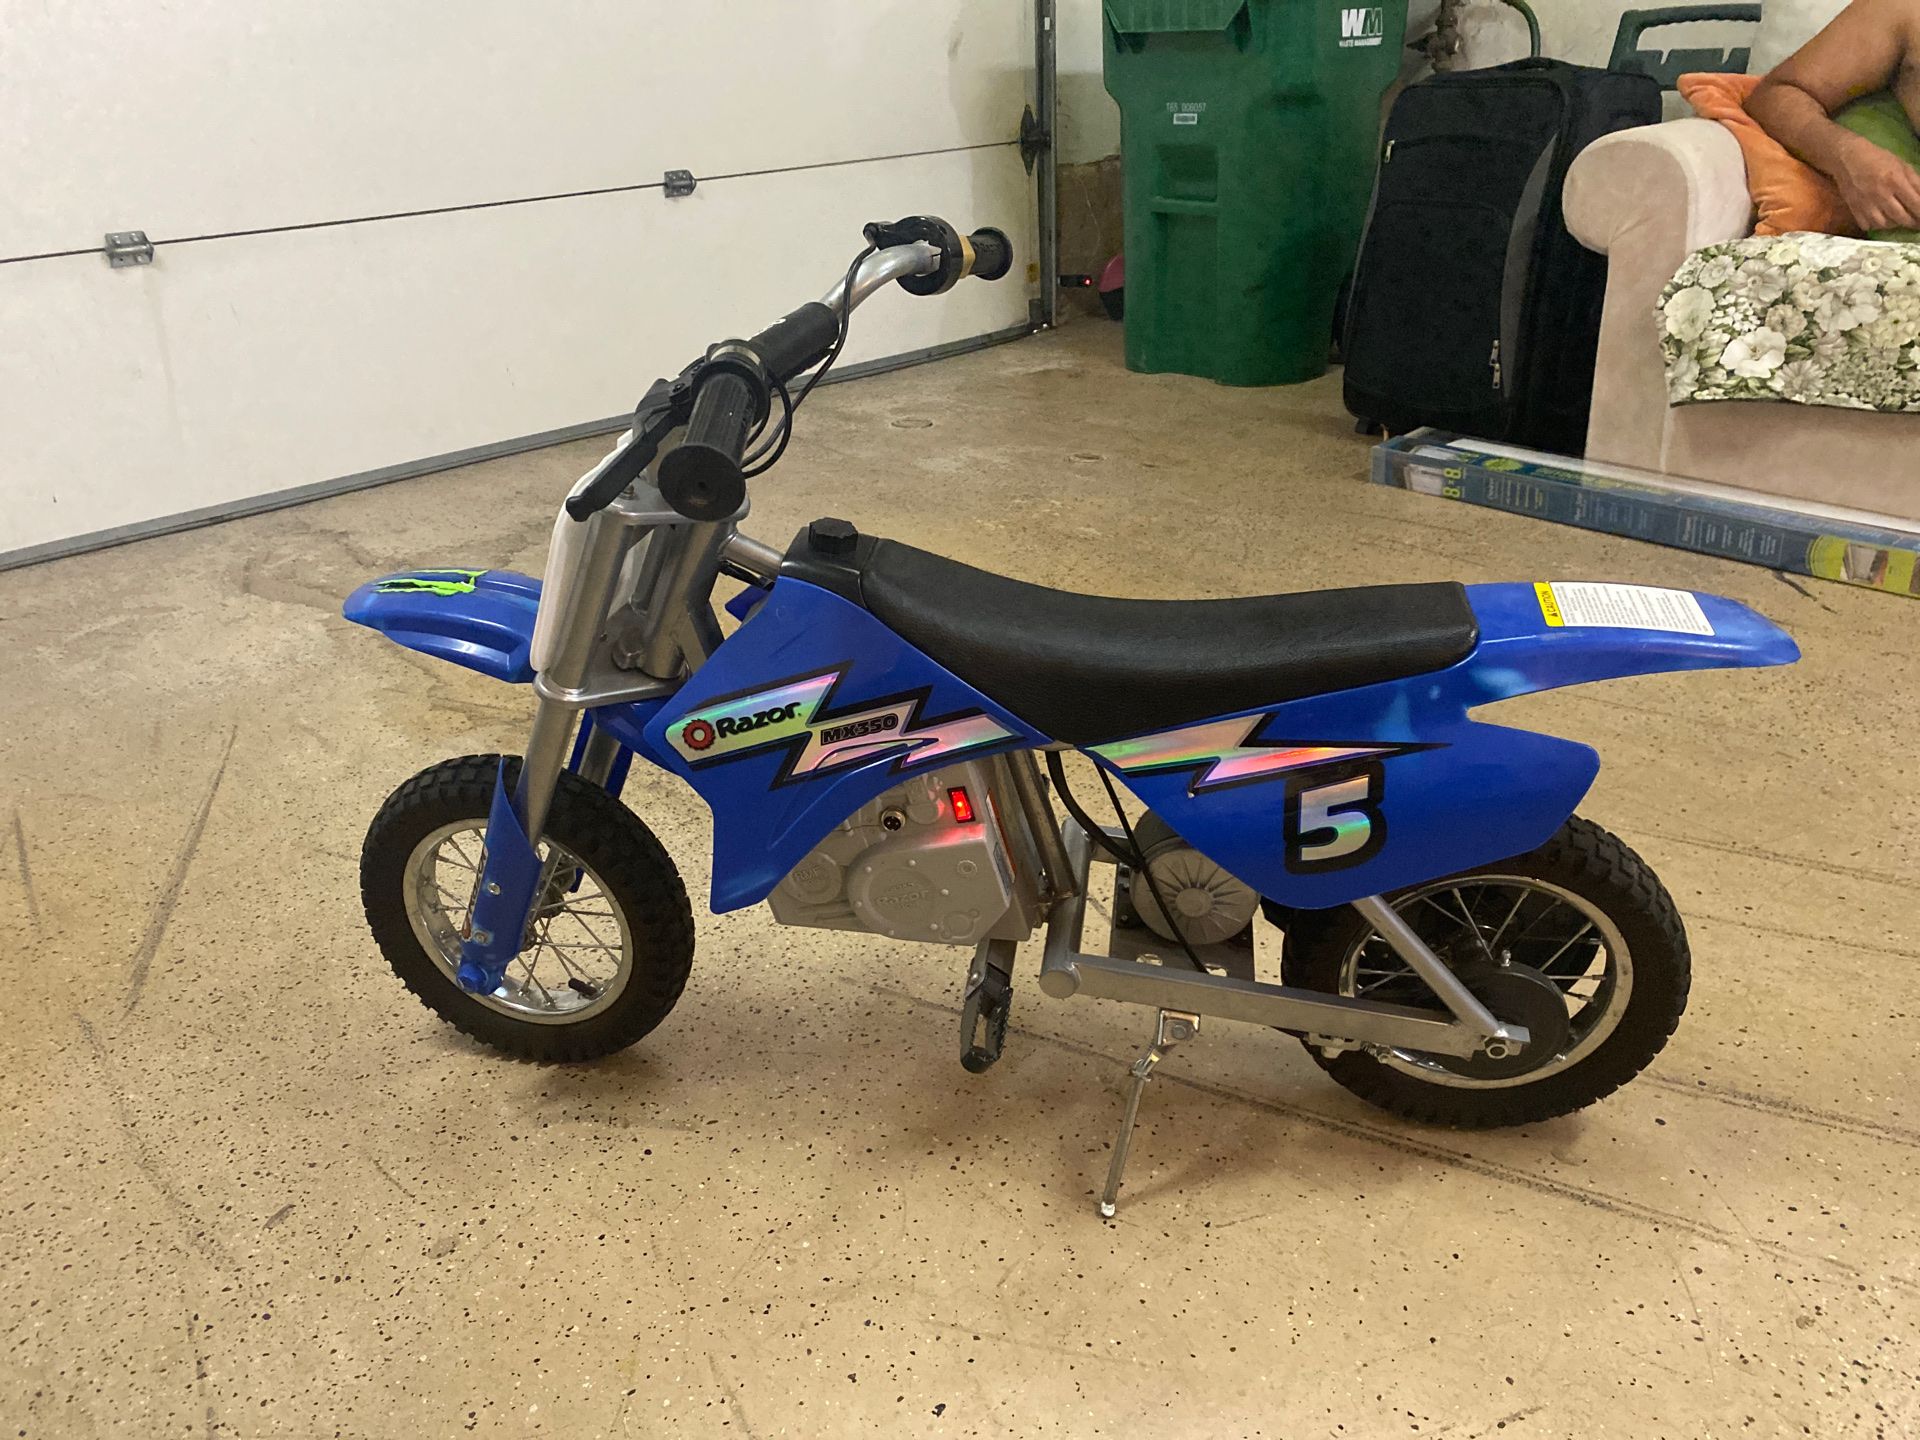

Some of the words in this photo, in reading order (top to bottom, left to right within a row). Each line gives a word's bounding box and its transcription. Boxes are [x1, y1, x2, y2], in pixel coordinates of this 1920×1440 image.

[1341, 7, 1383, 37] WM
[1443, 468, 1461, 479] 8
[1443, 487, 1460, 498] 8
[1541, 590, 1556, 614] CAUTION
[715, 702, 800, 738] Razor
[821, 713, 898, 746] MX350
[1296, 772, 1374, 864] 5
